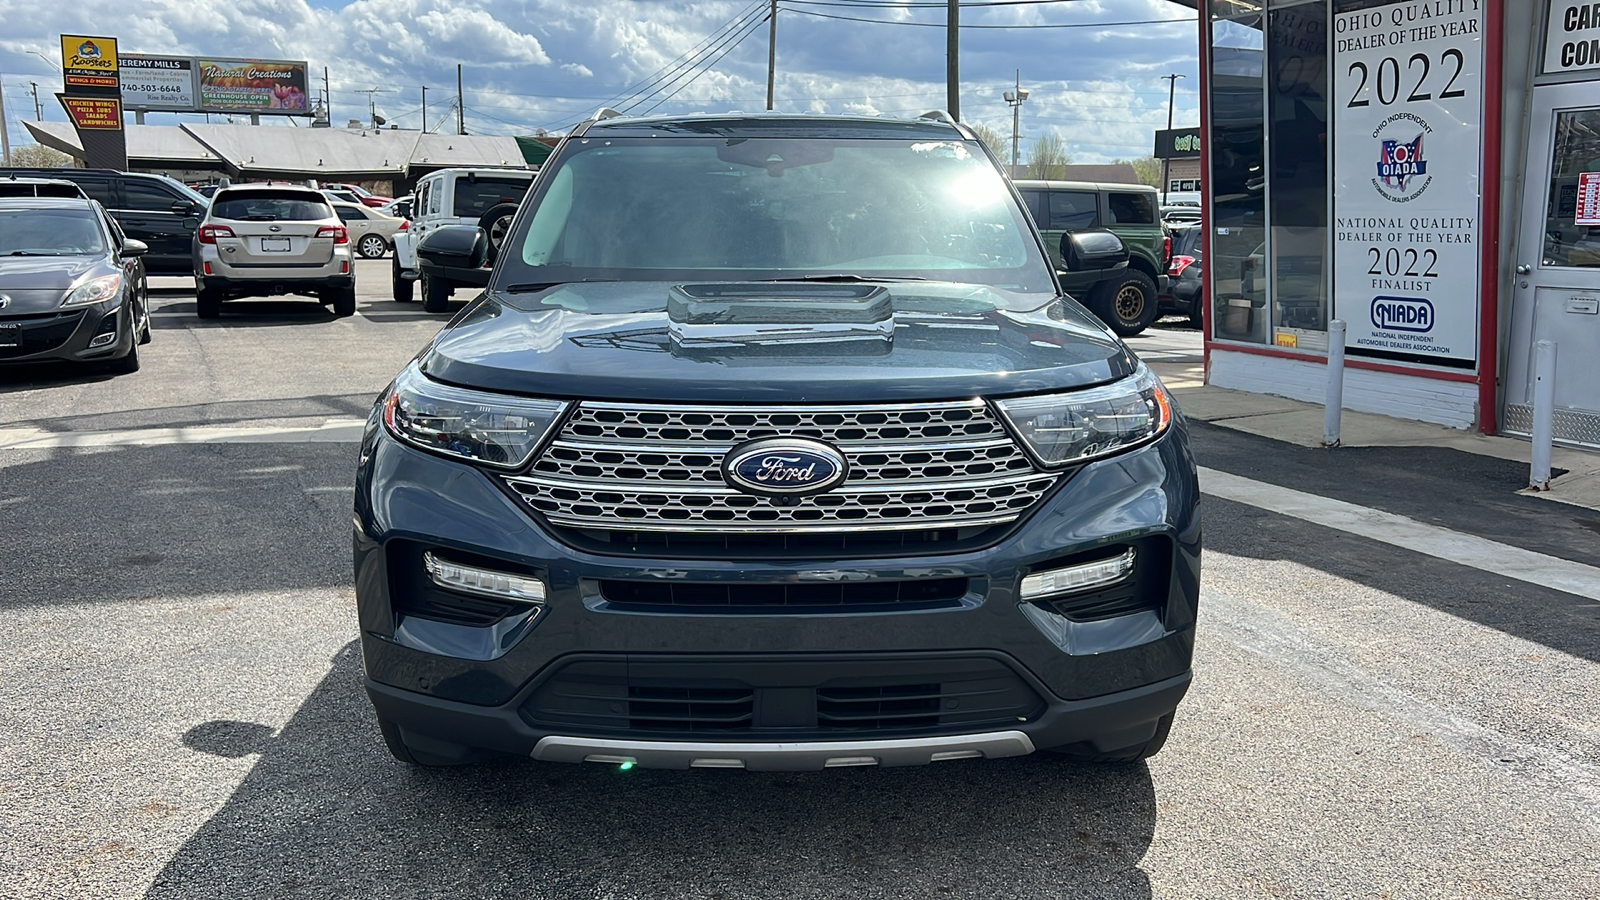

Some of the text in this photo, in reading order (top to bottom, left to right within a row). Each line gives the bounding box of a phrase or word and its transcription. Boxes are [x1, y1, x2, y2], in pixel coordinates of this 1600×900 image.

[1336, 0, 1480, 34] OHIO QUALITY
[1338, 32, 1386, 53] DEALER
[1389, 29, 1406, 45] OF
[1410, 25, 1437, 42] THE
[1440, 18, 1478, 39] YEAR
[69, 55, 112, 68] Roosters
[118, 59, 181, 69] JEREMY MILLS
[204, 66, 293, 79] Natural Creations
[1346, 48, 1466, 109] 2022
[121, 83, 181, 93] 740-503-6648
[161, 94, 179, 103] Realty
[1372, 112, 1433, 138] OHIO INDEPENDENT
[1382, 162, 1418, 175] OIADA
[1371, 177, 1392, 201] AUTOMOBILE
[1410, 175, 1433, 201] ASSOCIATION
[1337, 217, 1474, 230] NATIONAL QUALITY
[1338, 231, 1472, 243] DEALER OF THE YEAR
[1367, 247, 1438, 278] 2022
[1371, 279, 1432, 291] FINALIST
[1375, 303, 1428, 326] NIADA
[1371, 331, 1434, 343] NATIONAL INDEPENDENT
[1356, 338, 1450, 354] AUTOMOBILE DEALERS ASSOCIATION
[755, 456, 816, 481] Ford
